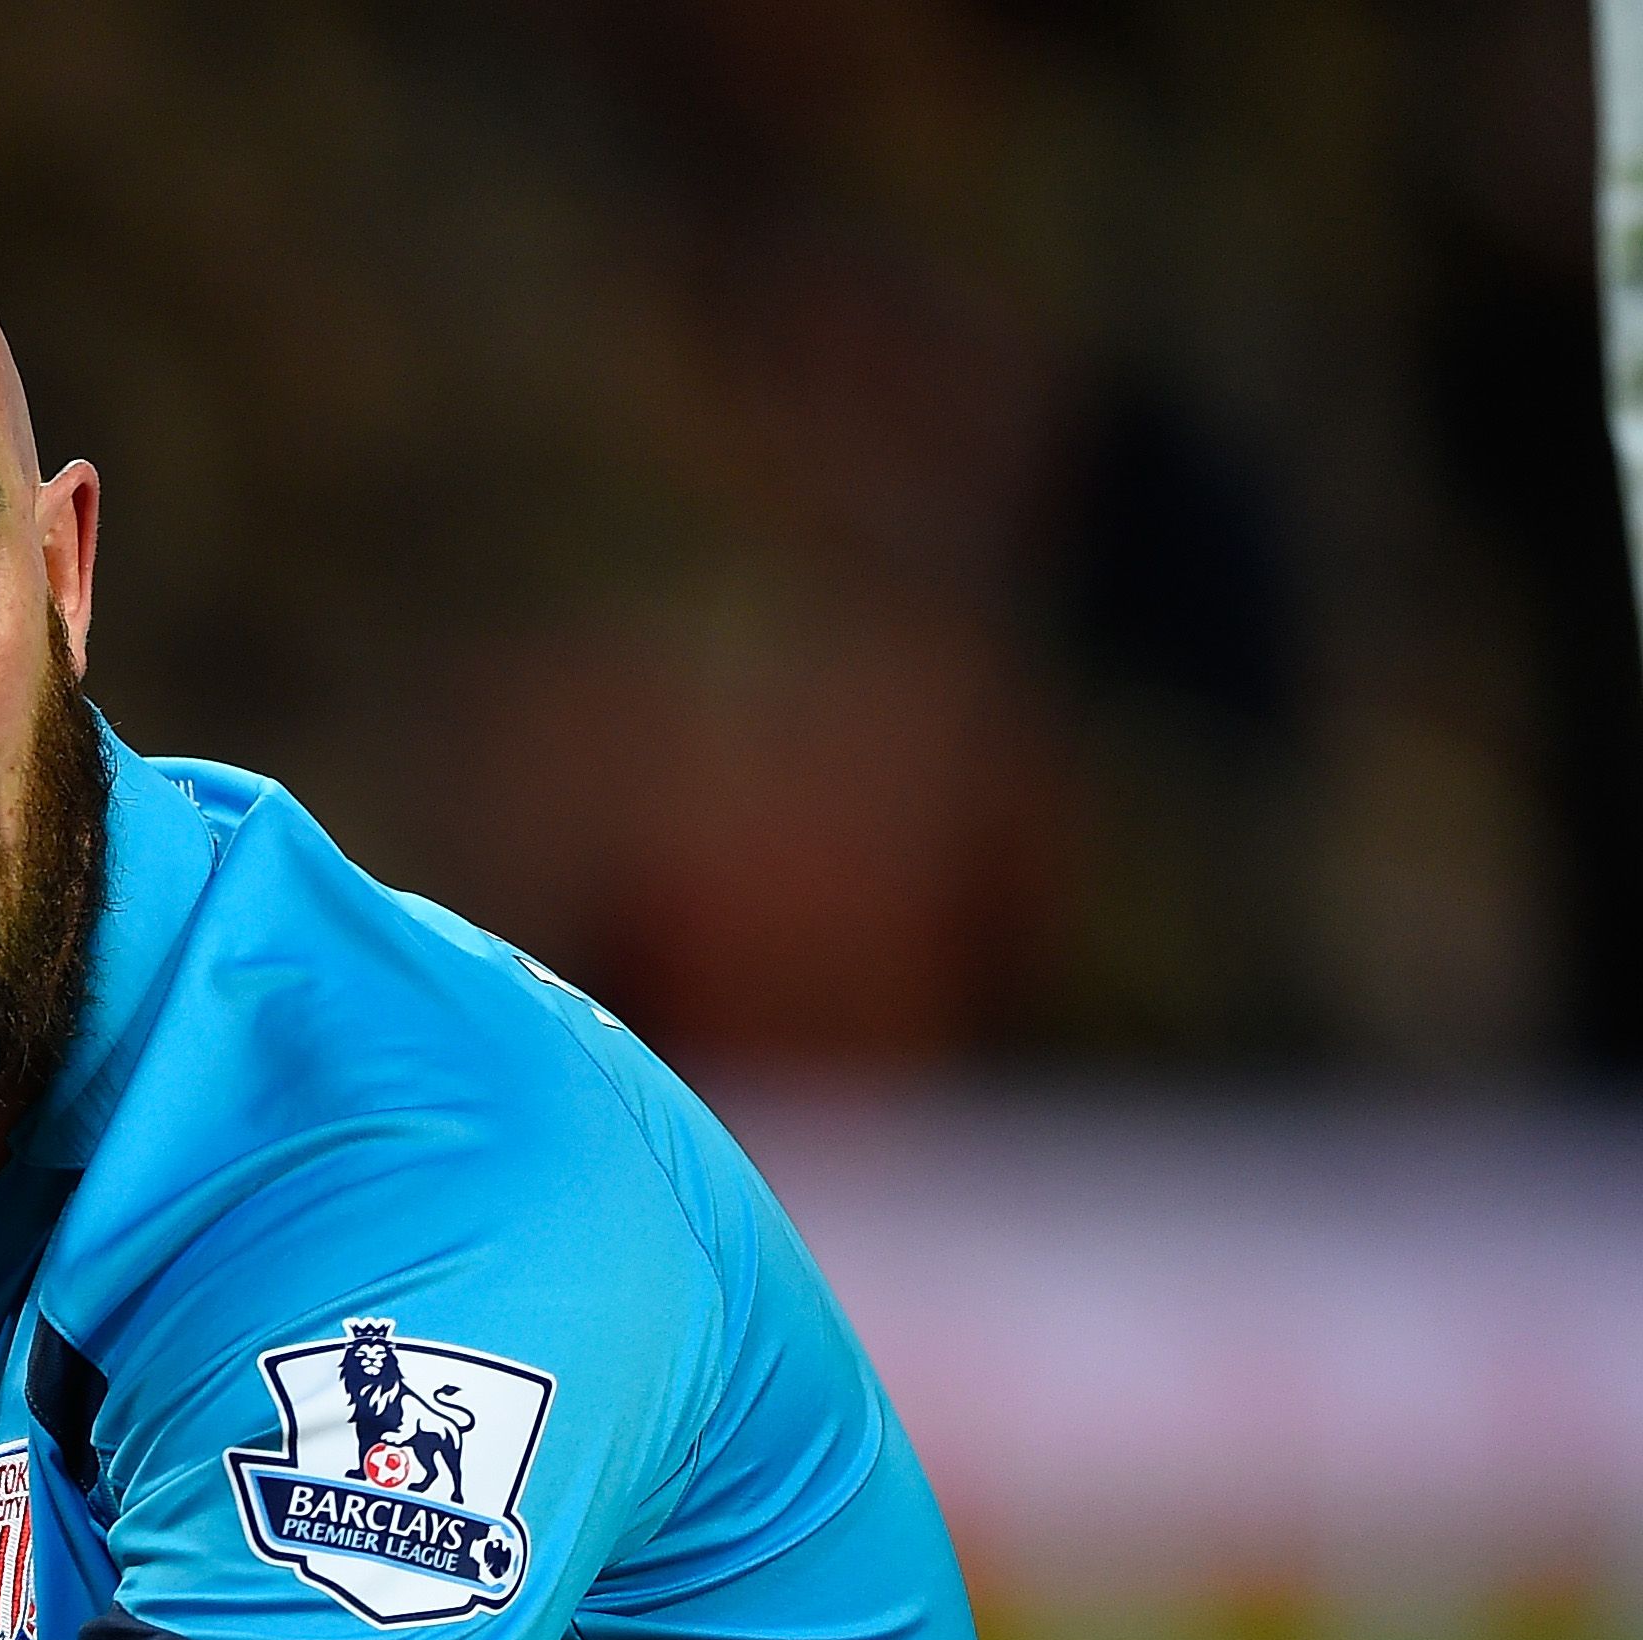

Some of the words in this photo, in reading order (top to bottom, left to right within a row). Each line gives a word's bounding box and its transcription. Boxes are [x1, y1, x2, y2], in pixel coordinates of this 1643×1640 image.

[282, 1517, 380, 1553] PREMIER
[384, 1536, 460, 1572] LEAGUE
[286, 1485, 466, 1550] BARCLAYS
